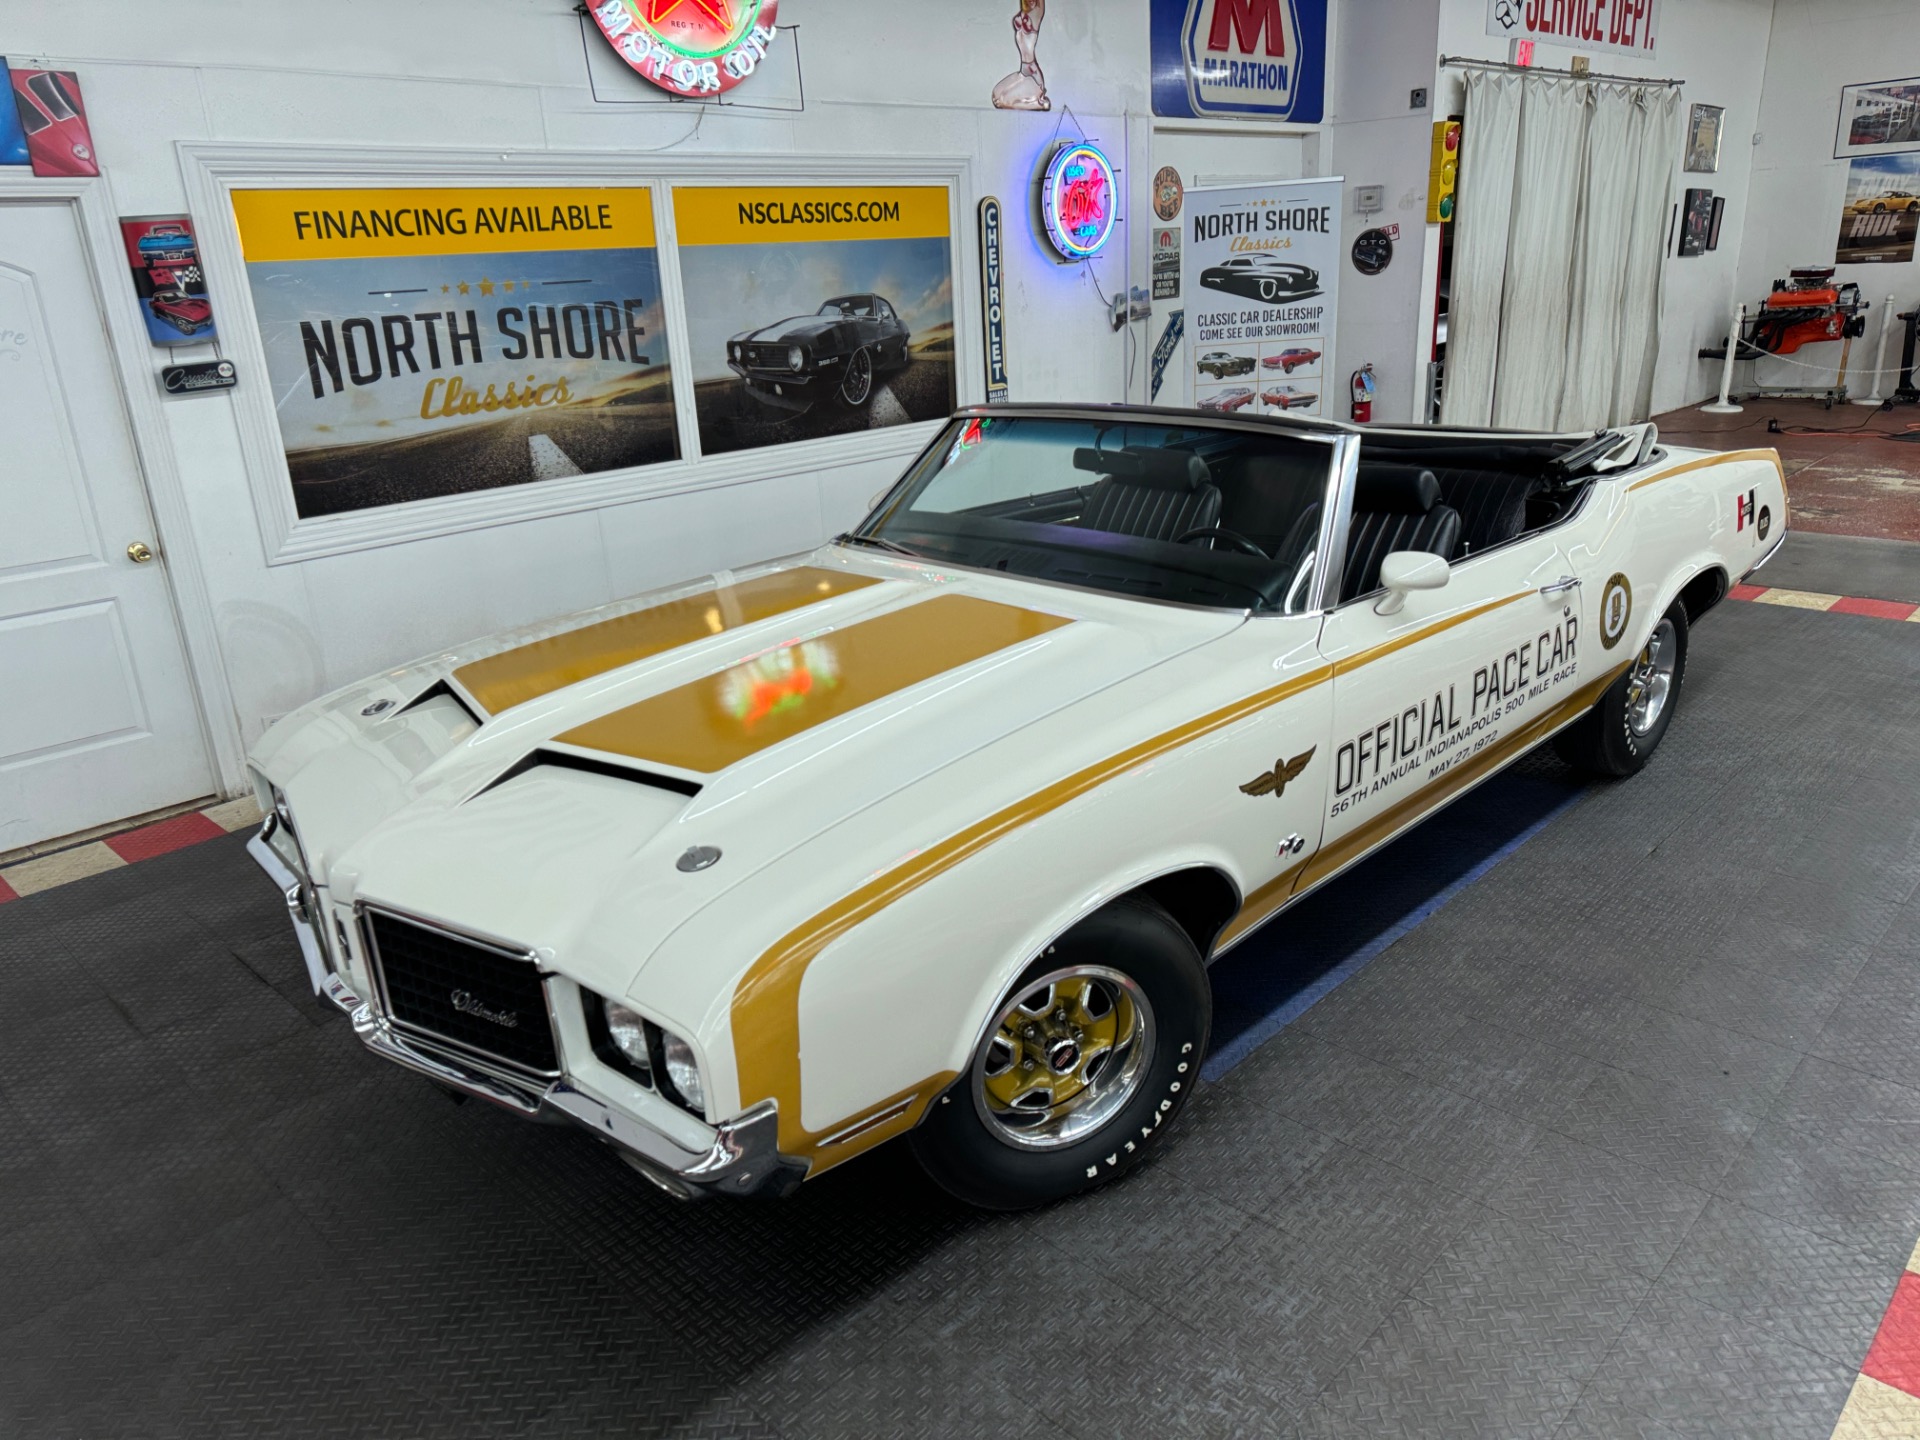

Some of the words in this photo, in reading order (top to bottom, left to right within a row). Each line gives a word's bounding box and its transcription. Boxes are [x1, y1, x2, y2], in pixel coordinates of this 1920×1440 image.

[1609, 0, 1655, 51] DEPT.
[595, 0, 721, 93] MOTOR
[722, 25, 777, 78] OIL
[1517, 40, 1535, 66] EXIT
[1202, 58, 1288, 91] MARATHON
[1066, 165, 1085, 177] USED
[1155, 169, 1181, 196] SUPER
[294, 207, 467, 240] FINANCING
[474, 204, 613, 235] AVAILABLE
[738, 201, 900, 225] NSCLASSICS.COM
[1160, 199, 1179, 218] BEE
[1080, 225, 1098, 237] CARS
[1195, 211, 1258, 243] NORTH
[1265, 206, 1330, 234] SHORE
[1380, 225, 1398, 236] OLD
[1849, 213, 1901, 238] RIDE
[1153, 251, 1180, 261] MOPAR
[1230, 235, 1293, 253] Classics
[986, 207, 1002, 380] CHEVROLET
[1197, 312, 1238, 327] CLASSIC
[1240, 309, 1260, 324] CAR
[1262, 306, 1323, 323] DEALERSHIP
[1200, 327, 1224, 341] COME
[1226, 326, 1242, 339] SEE
[1245, 325, 1263, 338] OUR
[1265, 321, 1320, 337] SHOWROOM!
[299, 309, 483, 400] NORTH
[496, 298, 650, 366] SHORE
[166, 368, 222, 390] Corvette
[420, 373, 575, 421] Classics
[1333, 683, 1461, 798] OFFICIAL
[1471, 639, 1532, 719] PACE
[1535, 614, 1579, 678] CAR
[1330, 787, 1368, 818] 56TH
[1370, 757, 1421, 796] ANNUAL
[1423, 708, 1502, 763] INDIANAPOLIS
[1504, 694, 1525, 714] 500
[1528, 681, 1550, 701] MILE
[1552, 662, 1578, 687] RACE
[1428, 757, 1453, 780] MAY
[1453, 746, 1471, 767] 27,
[1473, 729, 1498, 751] 1972
[451, 988, 518, 1029] Oldsmobile
[1086, 1042, 1192, 1179] GOODYEAR
